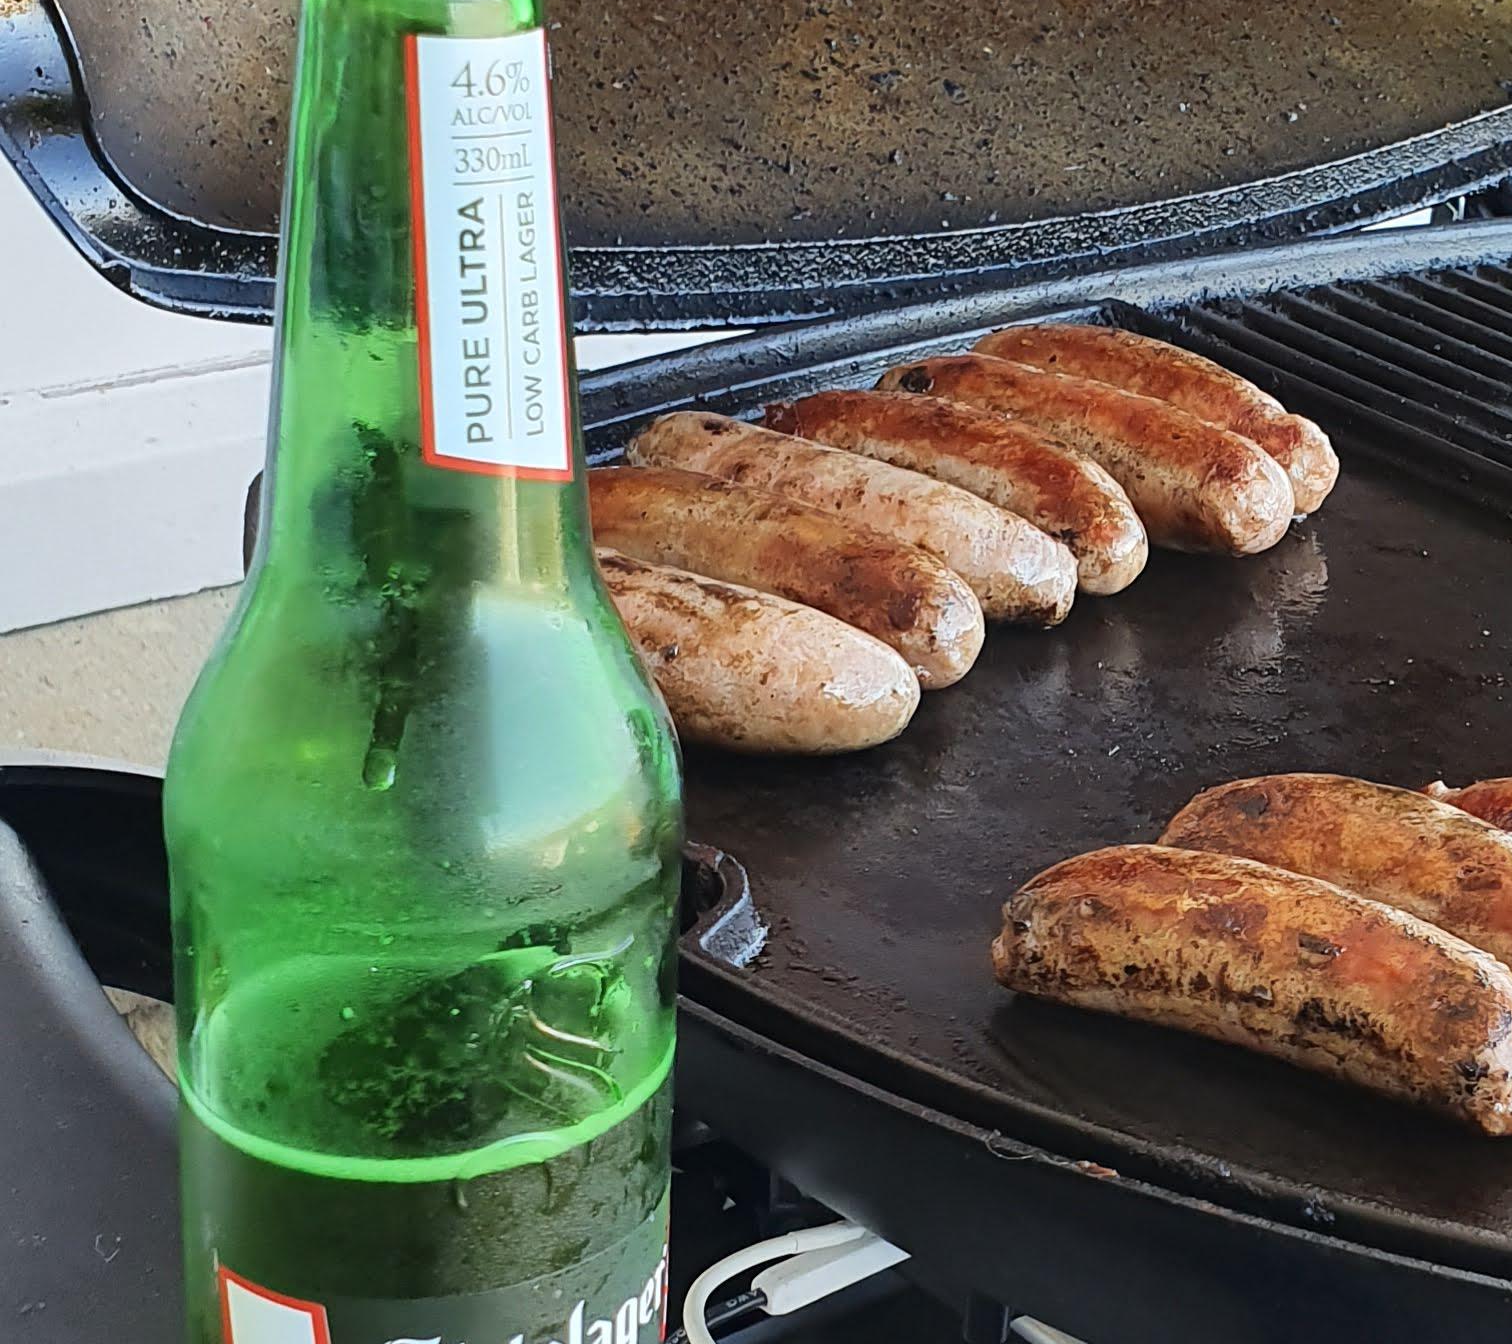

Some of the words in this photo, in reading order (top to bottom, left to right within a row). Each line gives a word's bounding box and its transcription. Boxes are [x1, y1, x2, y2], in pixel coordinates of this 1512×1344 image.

[449, 59, 530, 97] 4.6%
[450, 102, 533, 126] ALC/VOL
[456, 197, 488, 328] ULTRA
[518, 190, 538, 283] LAGER
[520, 289, 541, 372] CARB
[464, 336, 494, 444] PURE
[525, 374, 544, 436] LOW
